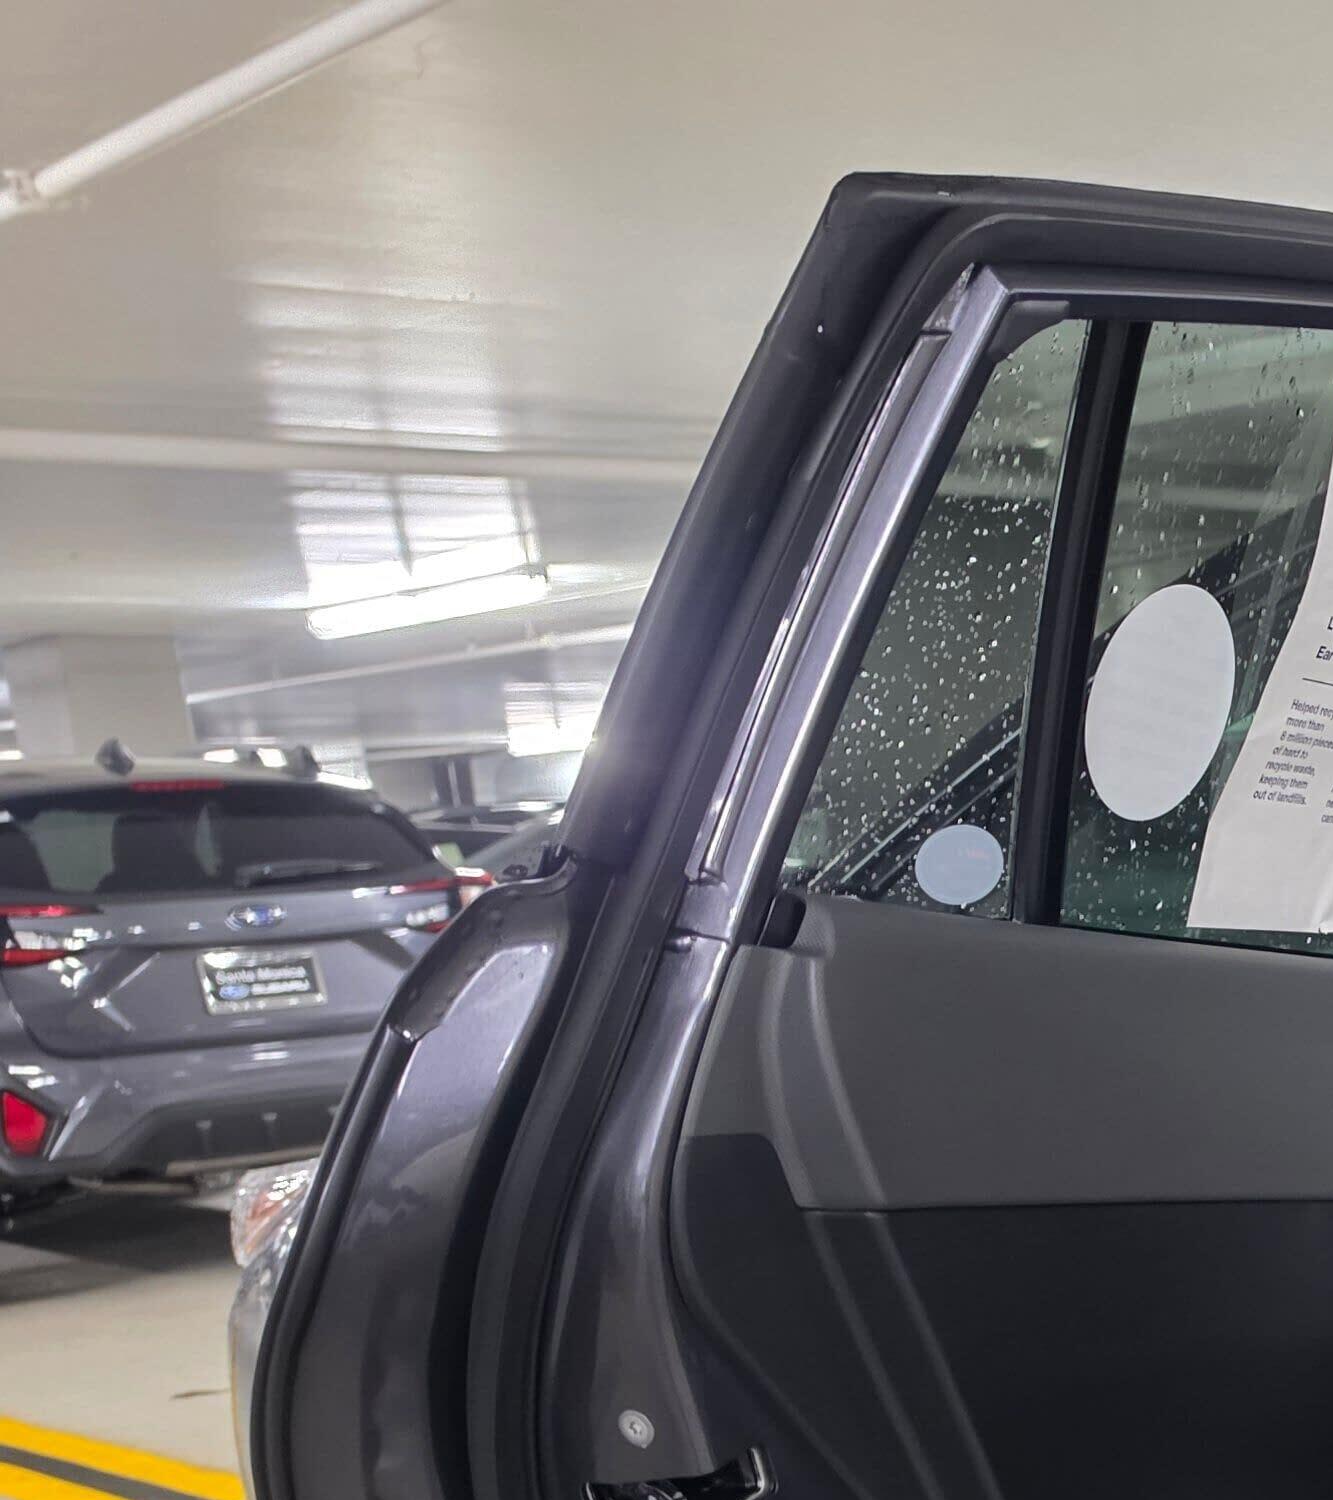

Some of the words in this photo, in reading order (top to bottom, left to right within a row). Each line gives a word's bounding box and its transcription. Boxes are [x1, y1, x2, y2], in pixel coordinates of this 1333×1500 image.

[1291, 699, 1320, 715] Helped
[1286, 717, 1307, 729] more
[1307, 719, 1325, 731] than
[1287, 732, 1312, 745] million
[1272, 745, 1284, 755] of
[1282, 747, 1301, 758] hard
[1300, 749, 1309, 759] to
[1265, 761, 1293, 773] recycle
[1259, 773, 1289, 789] keeping
[1289, 778, 1308, 789] them
[1253, 790, 1267, 800] out
[1267, 791, 1278, 801] of
